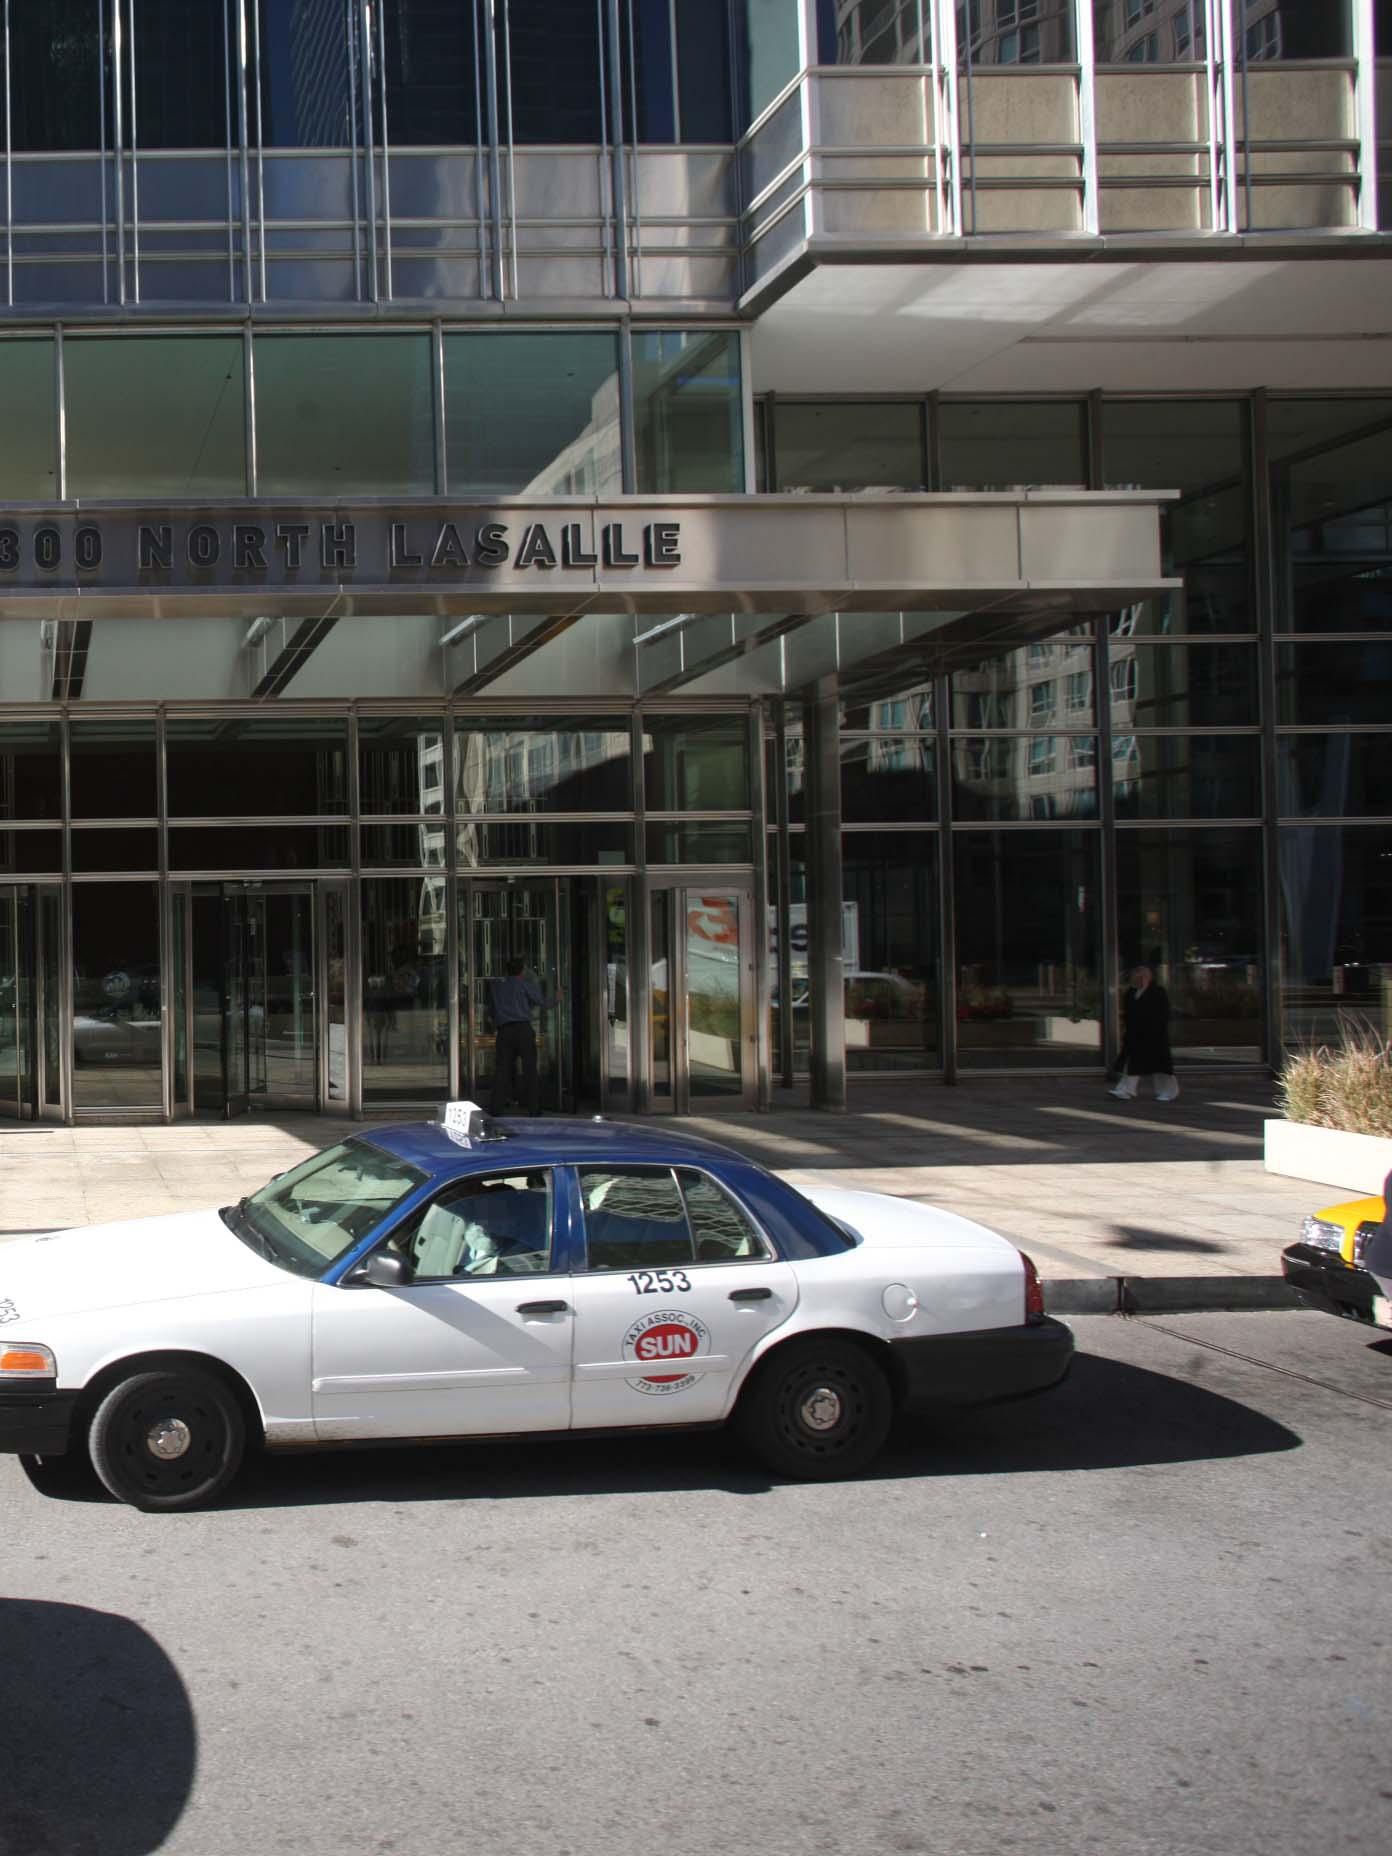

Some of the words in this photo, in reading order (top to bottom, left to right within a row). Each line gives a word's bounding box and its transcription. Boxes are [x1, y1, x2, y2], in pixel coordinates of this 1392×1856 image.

[138, 523, 357, 568] NORTH
[388, 521, 681, 568] LASALLE
[627, 1271, 691, 1295] 1253
[626, 1322, 646, 1346] TAXI
[639, 1332, 691, 1358] SUN
